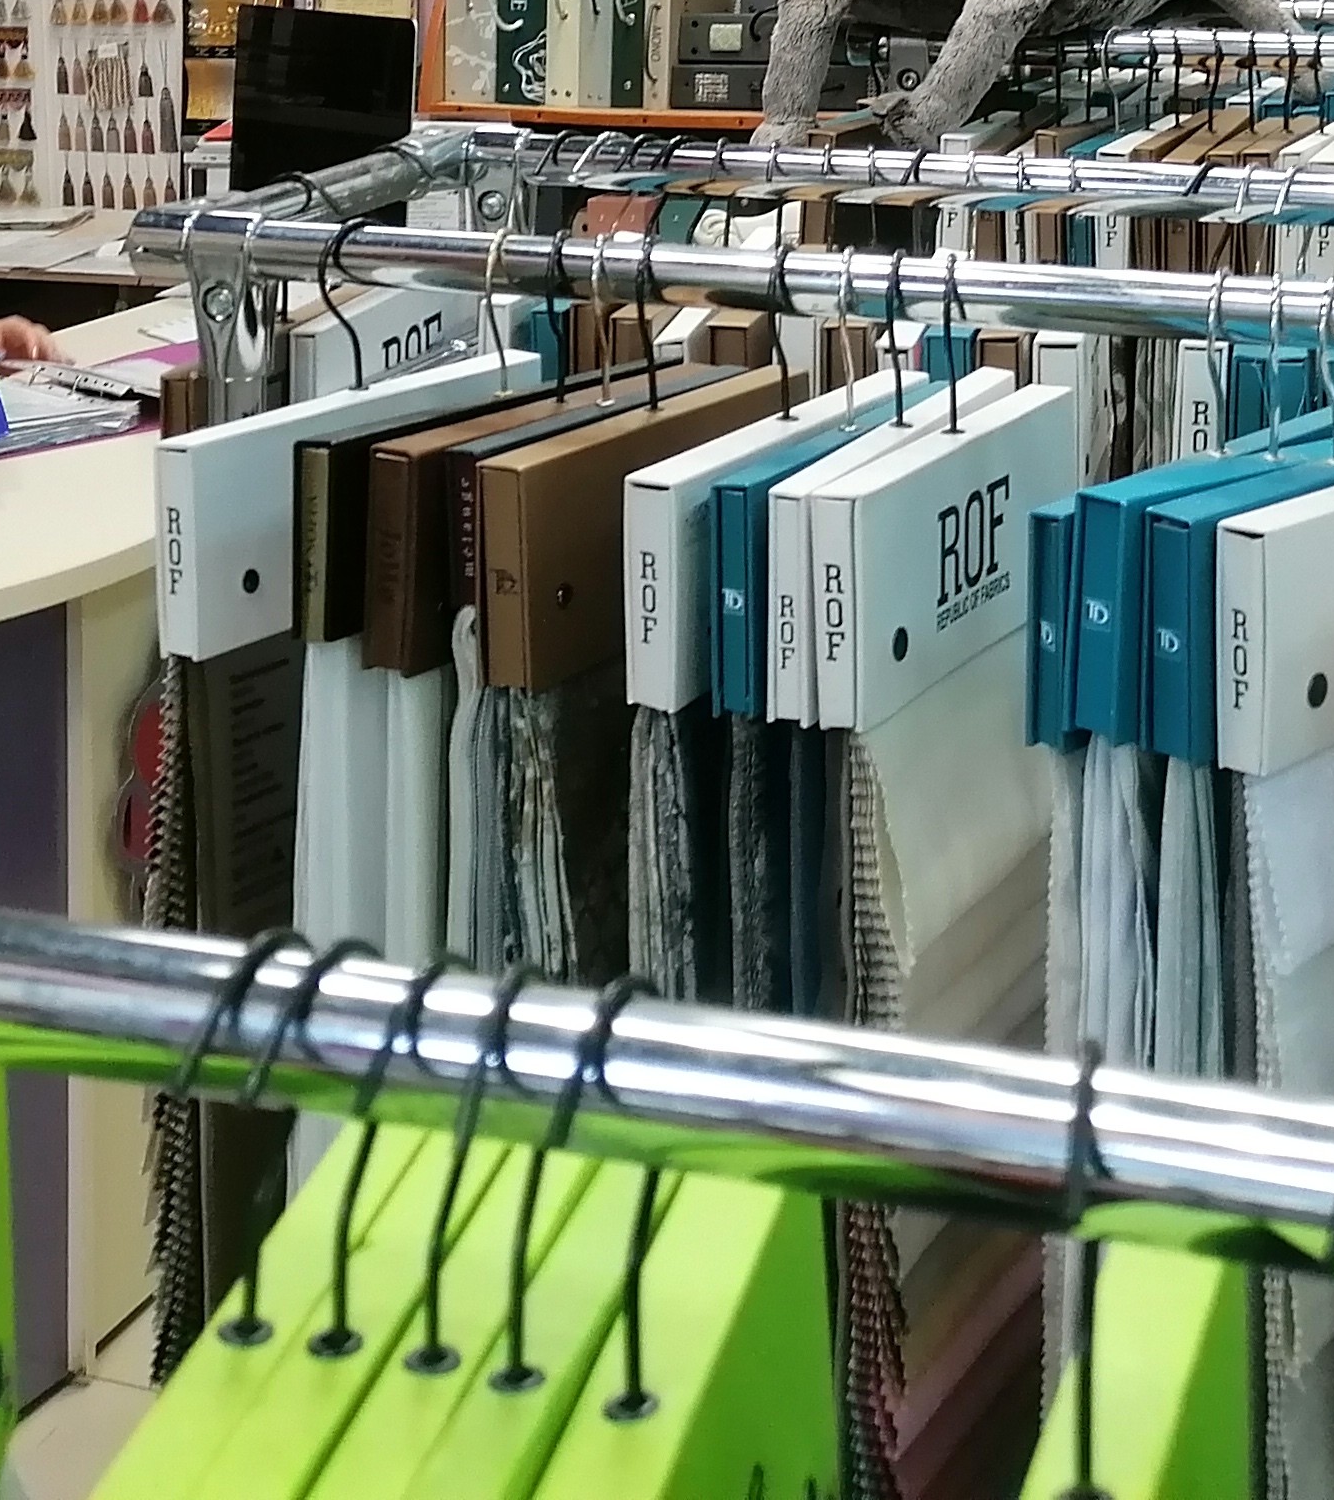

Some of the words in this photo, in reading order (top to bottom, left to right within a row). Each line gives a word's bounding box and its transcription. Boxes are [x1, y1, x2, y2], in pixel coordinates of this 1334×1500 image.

[651, 25, 663, 62] MONO
[1191, 401, 1210, 452] RO
[167, 507, 183, 596] ROF
[937, 474, 1010, 607] ROF
[640, 551, 657, 644] ROF
[780, 595, 795, 669] ROF
[825, 564, 845, 661] ROF
[1086, 601, 1109, 625] TD
[1158, 628, 1179, 654] TD
[1232, 608, 1249, 709] ROF
